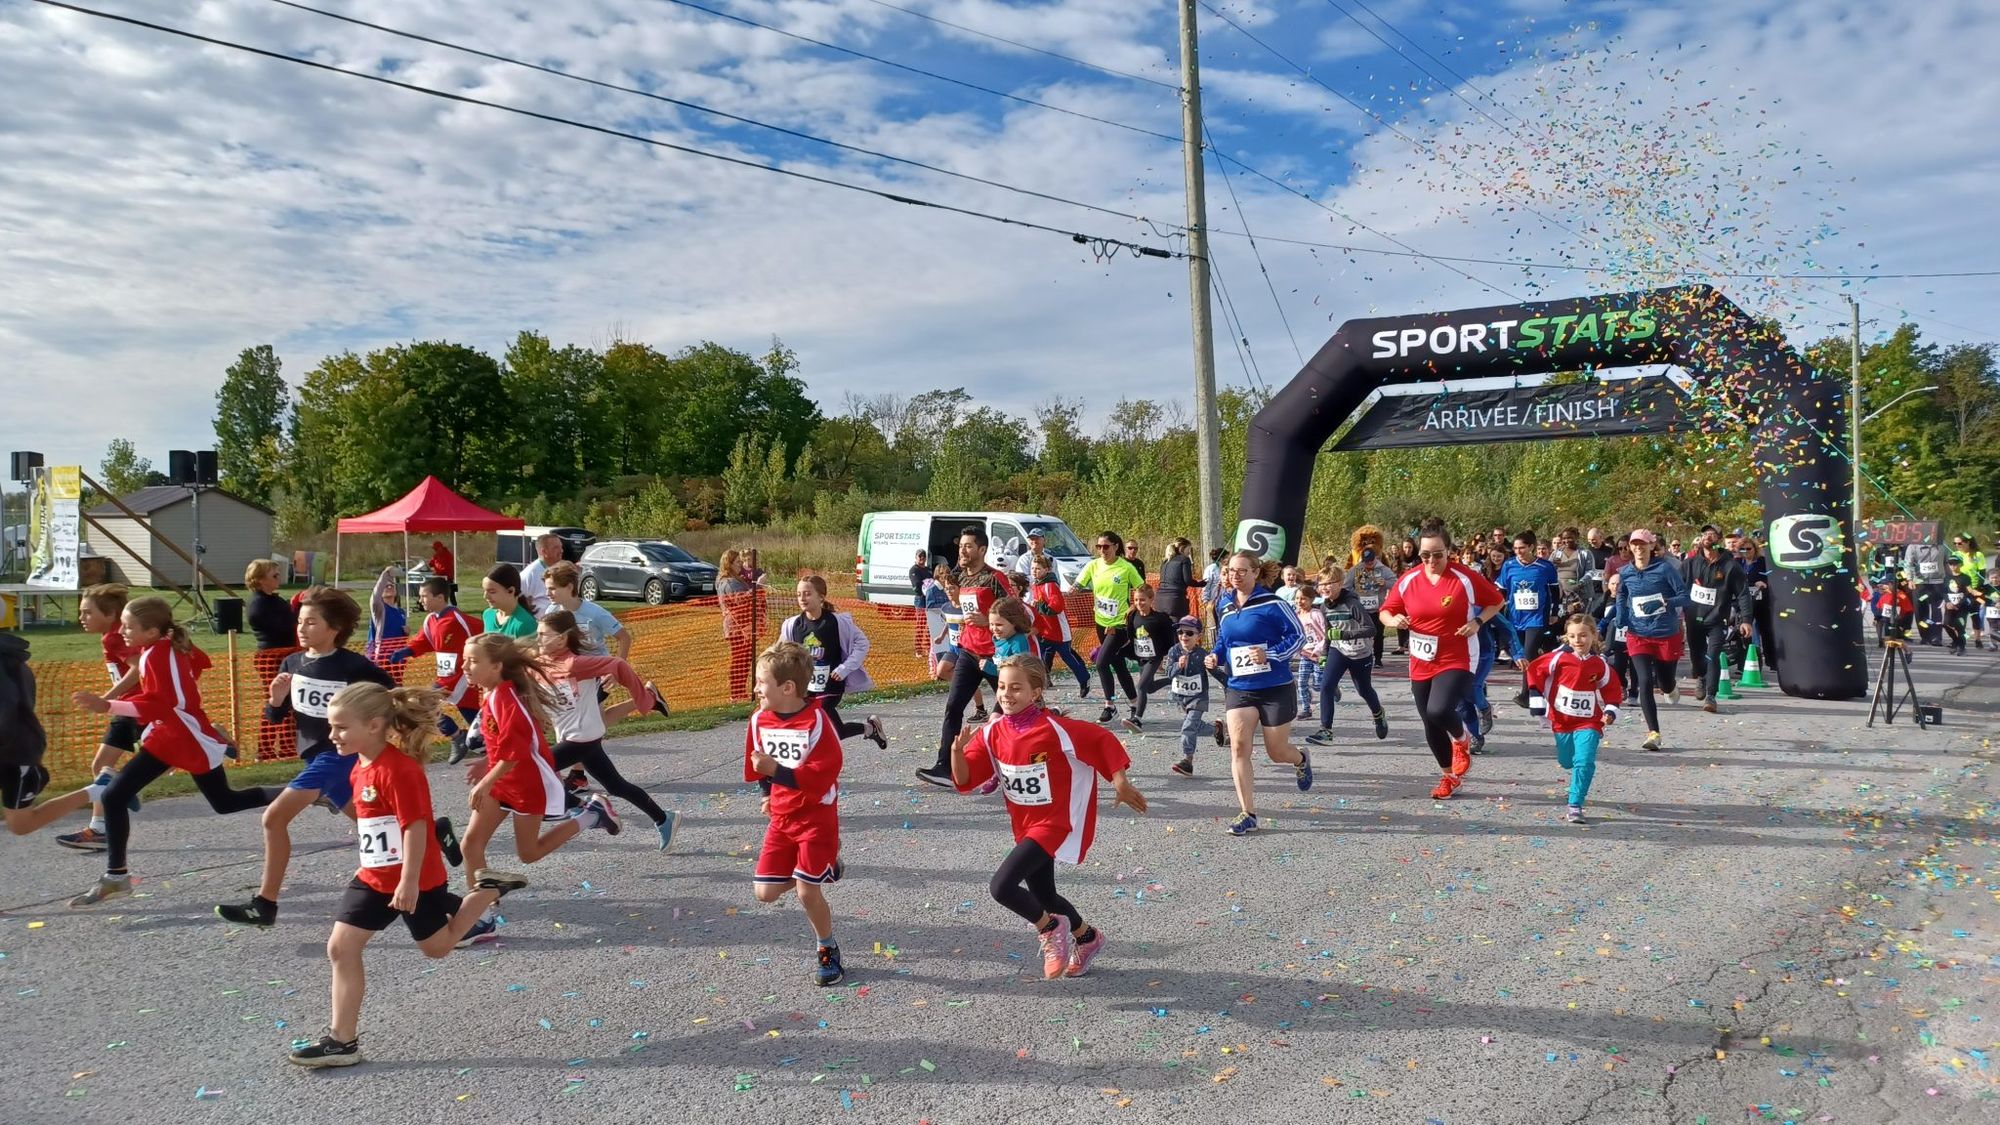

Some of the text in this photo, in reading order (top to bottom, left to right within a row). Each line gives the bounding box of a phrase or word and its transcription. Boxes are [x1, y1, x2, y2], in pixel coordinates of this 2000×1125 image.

[1372, 308, 1657, 359] SPORTSTATS
[874, 531, 921, 541] SPORTSTATS
[767, 741, 802, 761] 285
